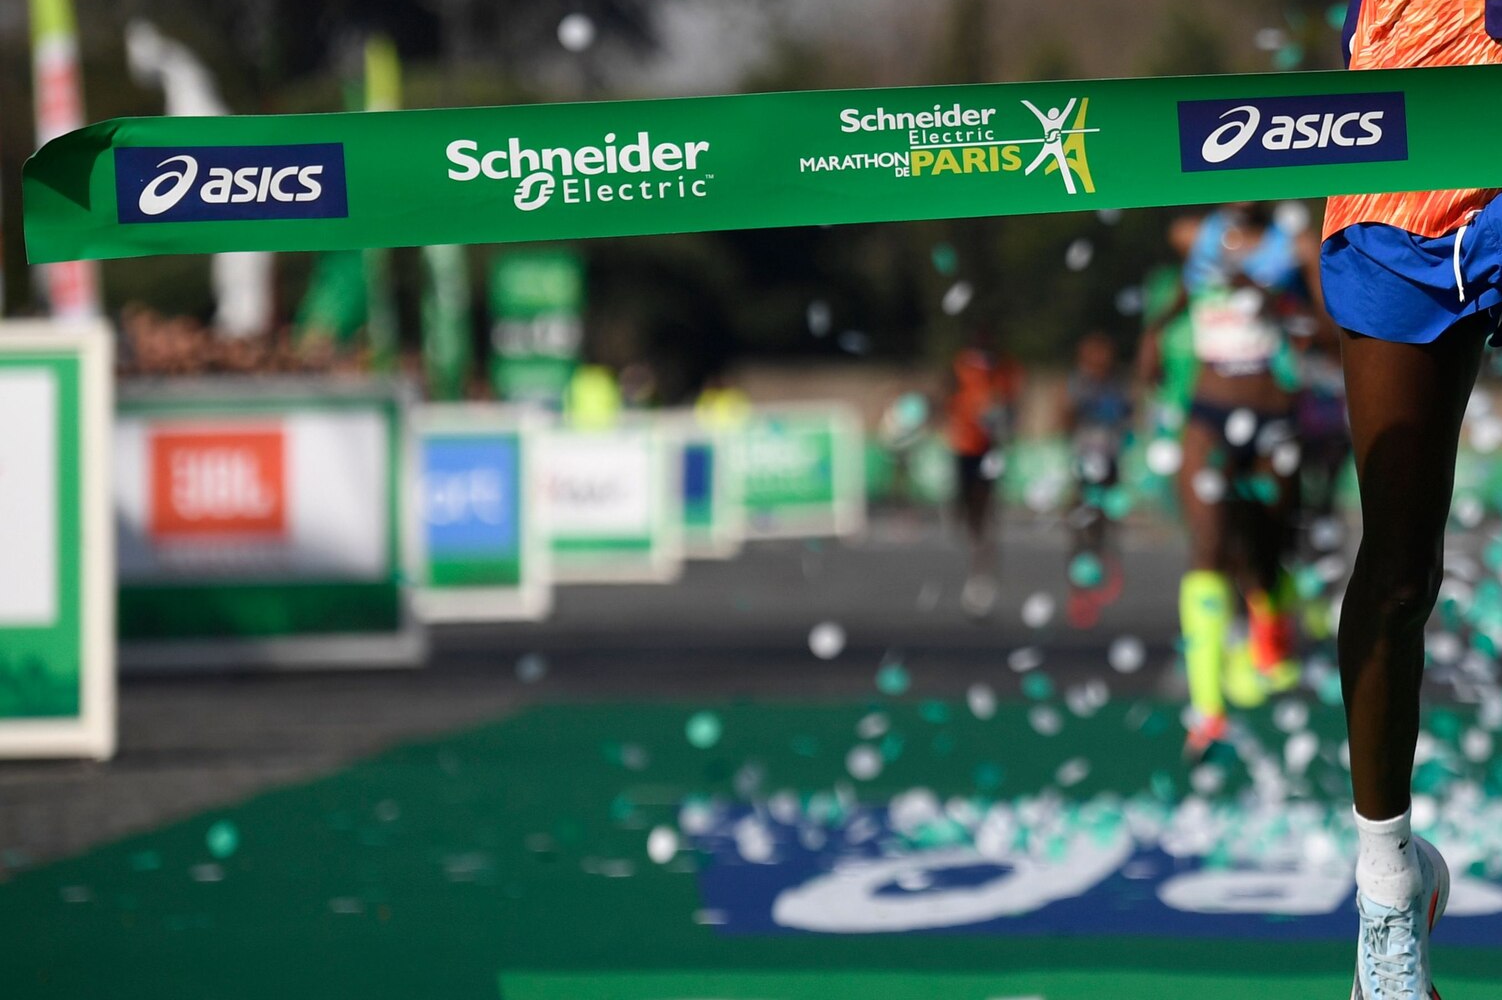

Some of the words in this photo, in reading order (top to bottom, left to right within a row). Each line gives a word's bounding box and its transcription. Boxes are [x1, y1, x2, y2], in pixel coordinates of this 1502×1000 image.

[839, 102, 997, 133] Schneider
[909, 129, 995, 145] Electric
[445, 132, 710, 182] Schneider
[800, 150, 910, 173] MARATHON
[895, 167, 910, 178] DE
[911, 145, 1022, 176] PARIS
[562, 178, 707, 204] Electric
